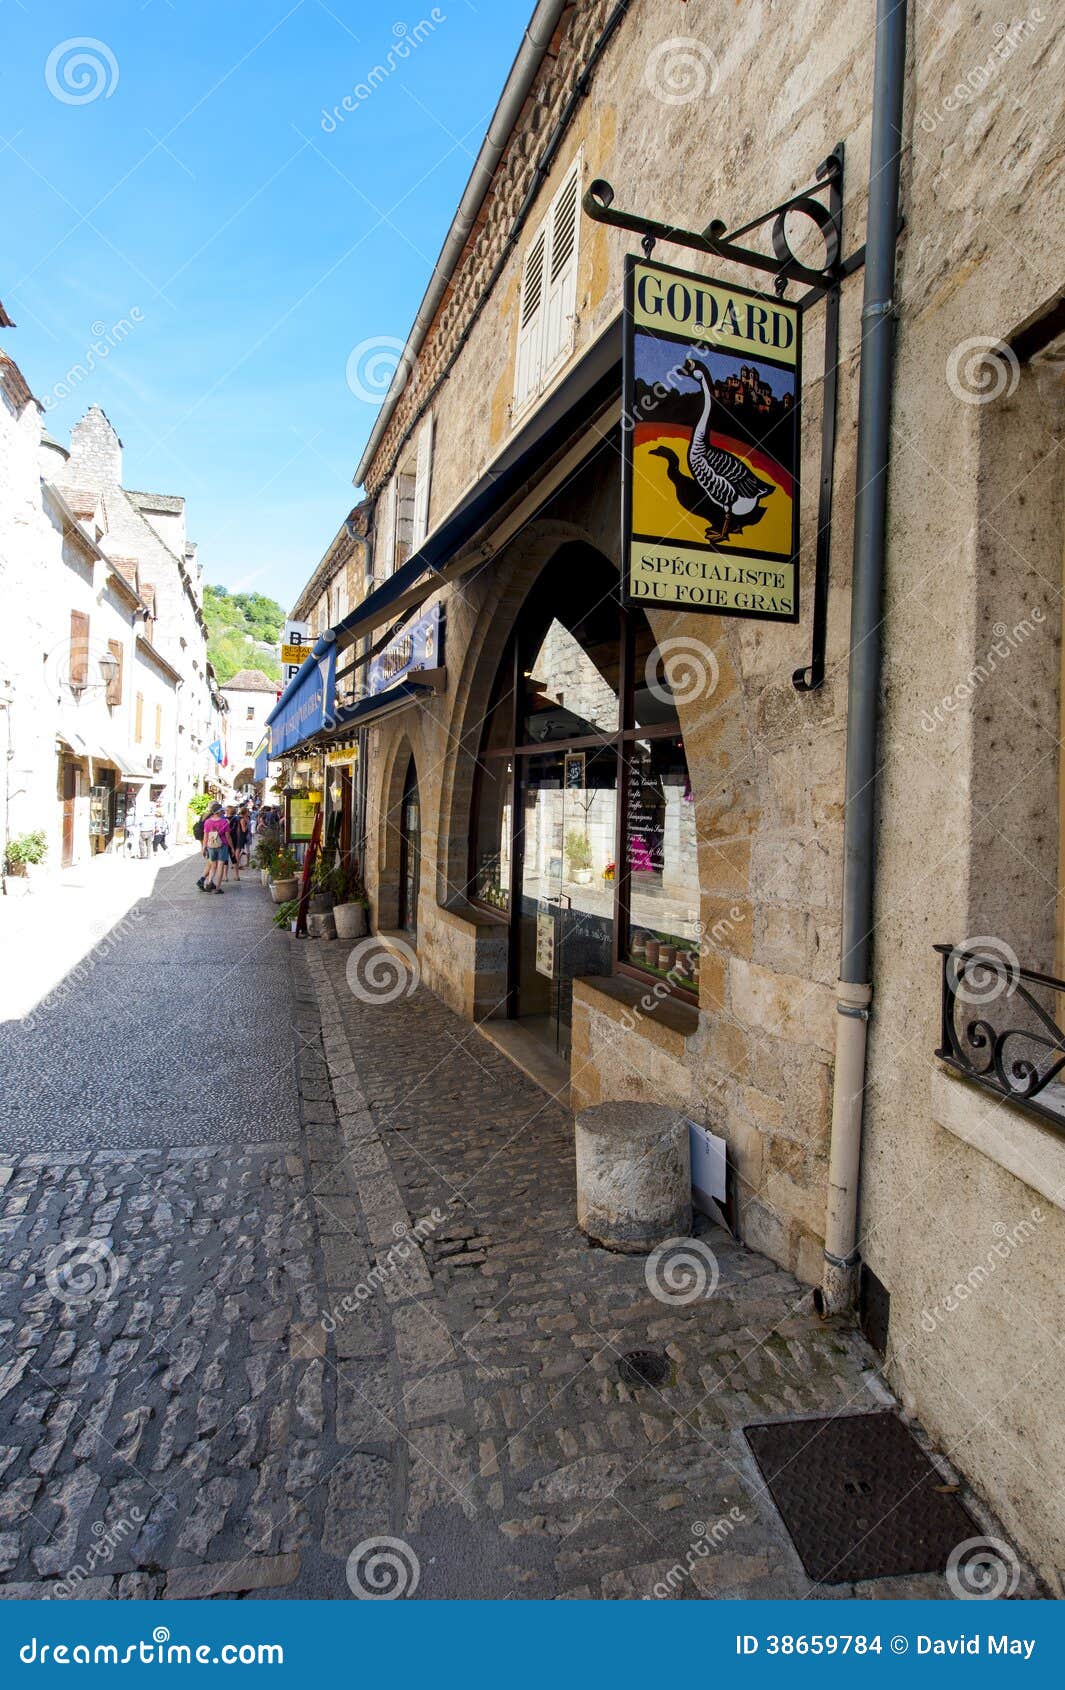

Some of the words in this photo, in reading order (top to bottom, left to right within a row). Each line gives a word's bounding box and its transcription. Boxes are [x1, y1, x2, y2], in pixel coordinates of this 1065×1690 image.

[638, 275, 794, 349] GODARD
[641, 555, 785, 589] SPÉCIALISTE
[633, 579, 667, 599] DU
[675, 584, 728, 606] FOIE
[734, 592, 792, 613] GRAS
